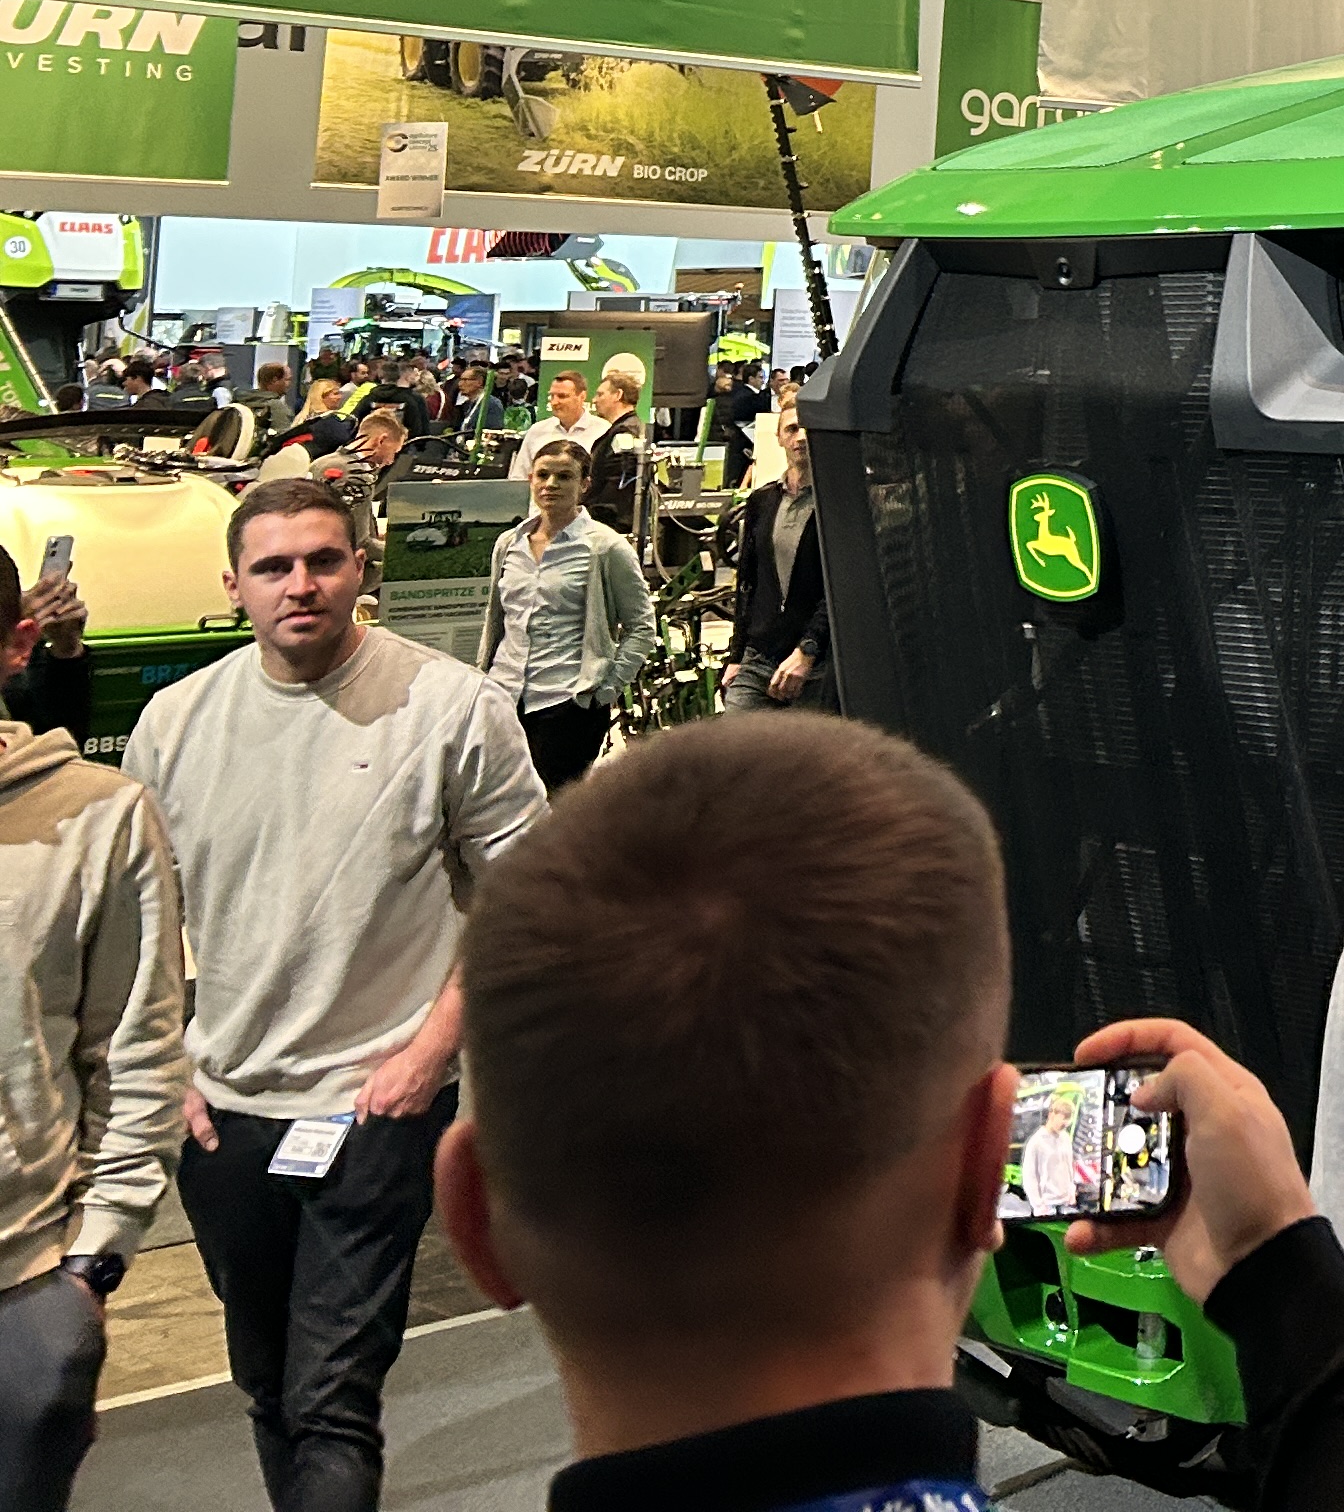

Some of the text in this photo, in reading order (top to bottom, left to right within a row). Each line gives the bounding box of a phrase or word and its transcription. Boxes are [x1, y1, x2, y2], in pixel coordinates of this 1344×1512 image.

[517, 149, 709, 183] ZÜRN BIO CROP
[59, 221, 114, 234] CLAAS
[10, 240, 27, 253] 30
[547, 343, 583, 352] ZÜRN
